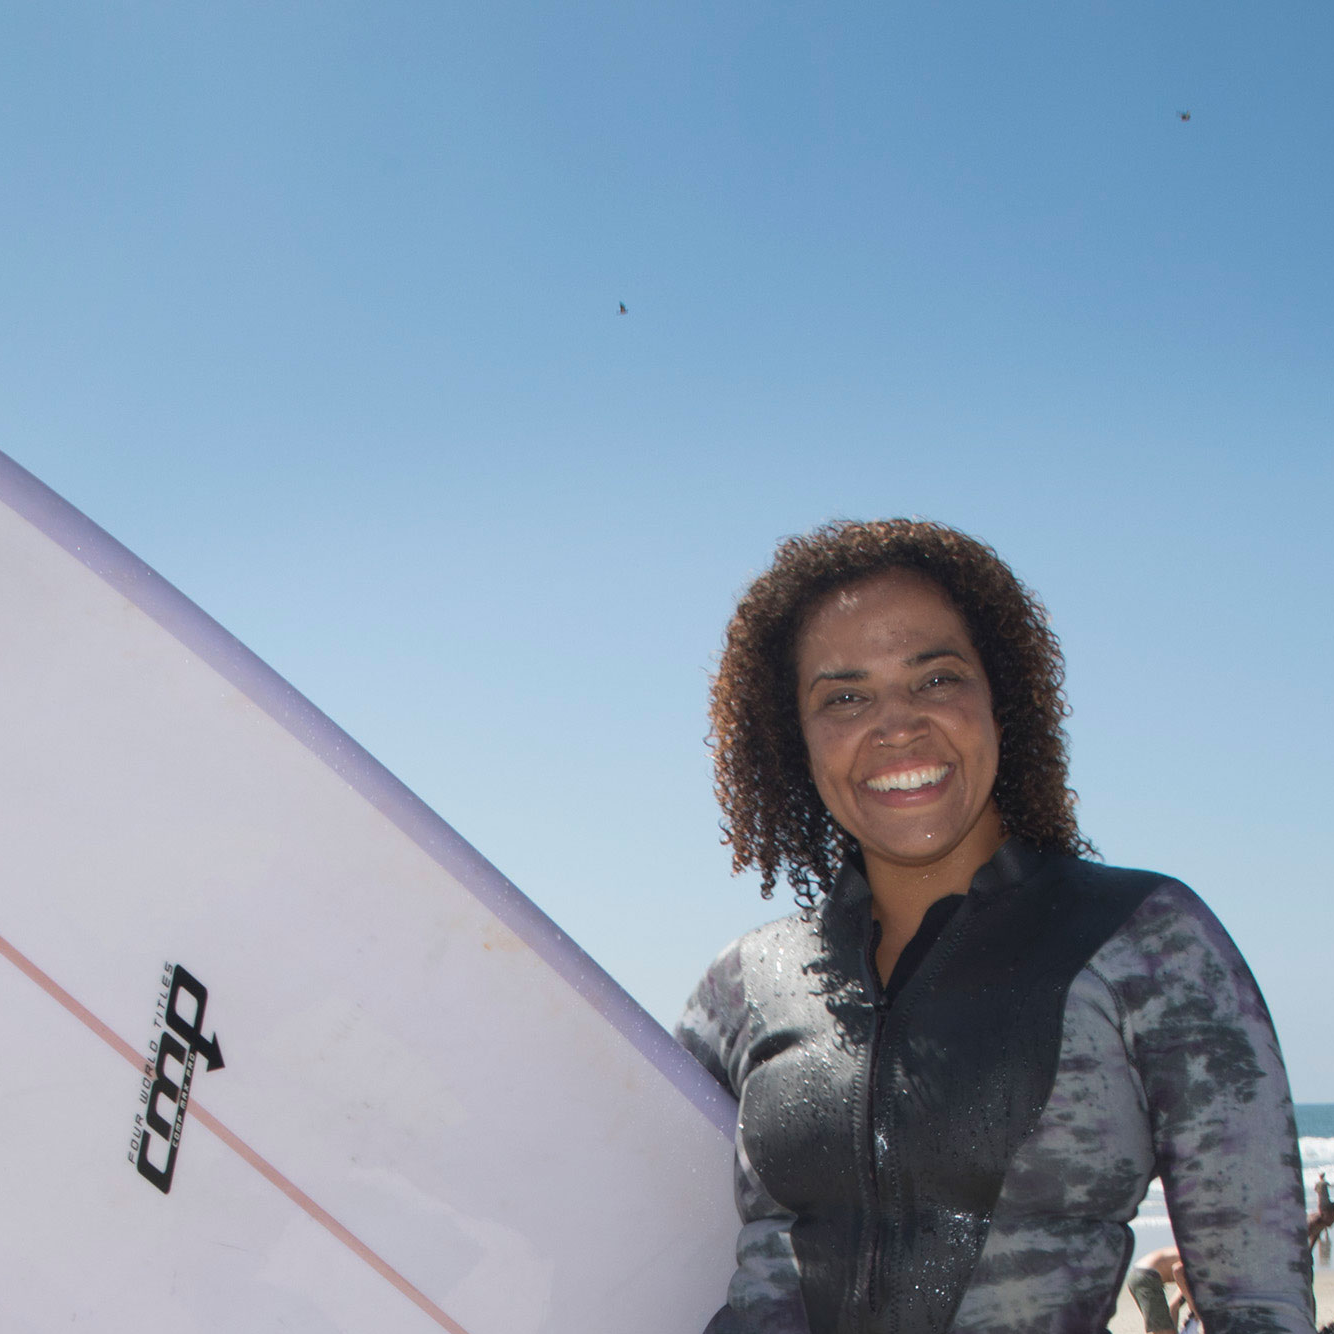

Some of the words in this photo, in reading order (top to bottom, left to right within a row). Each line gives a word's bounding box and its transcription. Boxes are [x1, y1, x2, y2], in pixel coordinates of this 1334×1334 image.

[128, 1114, 144, 1165] FOUR
[139, 1040, 159, 1105] WORLD
[153, 960, 174, 1029] TITLES
[172, 1114, 183, 1148] COMP
[179, 1083, 191, 1111] MAX
[185, 1053, 196, 1078] PRO
